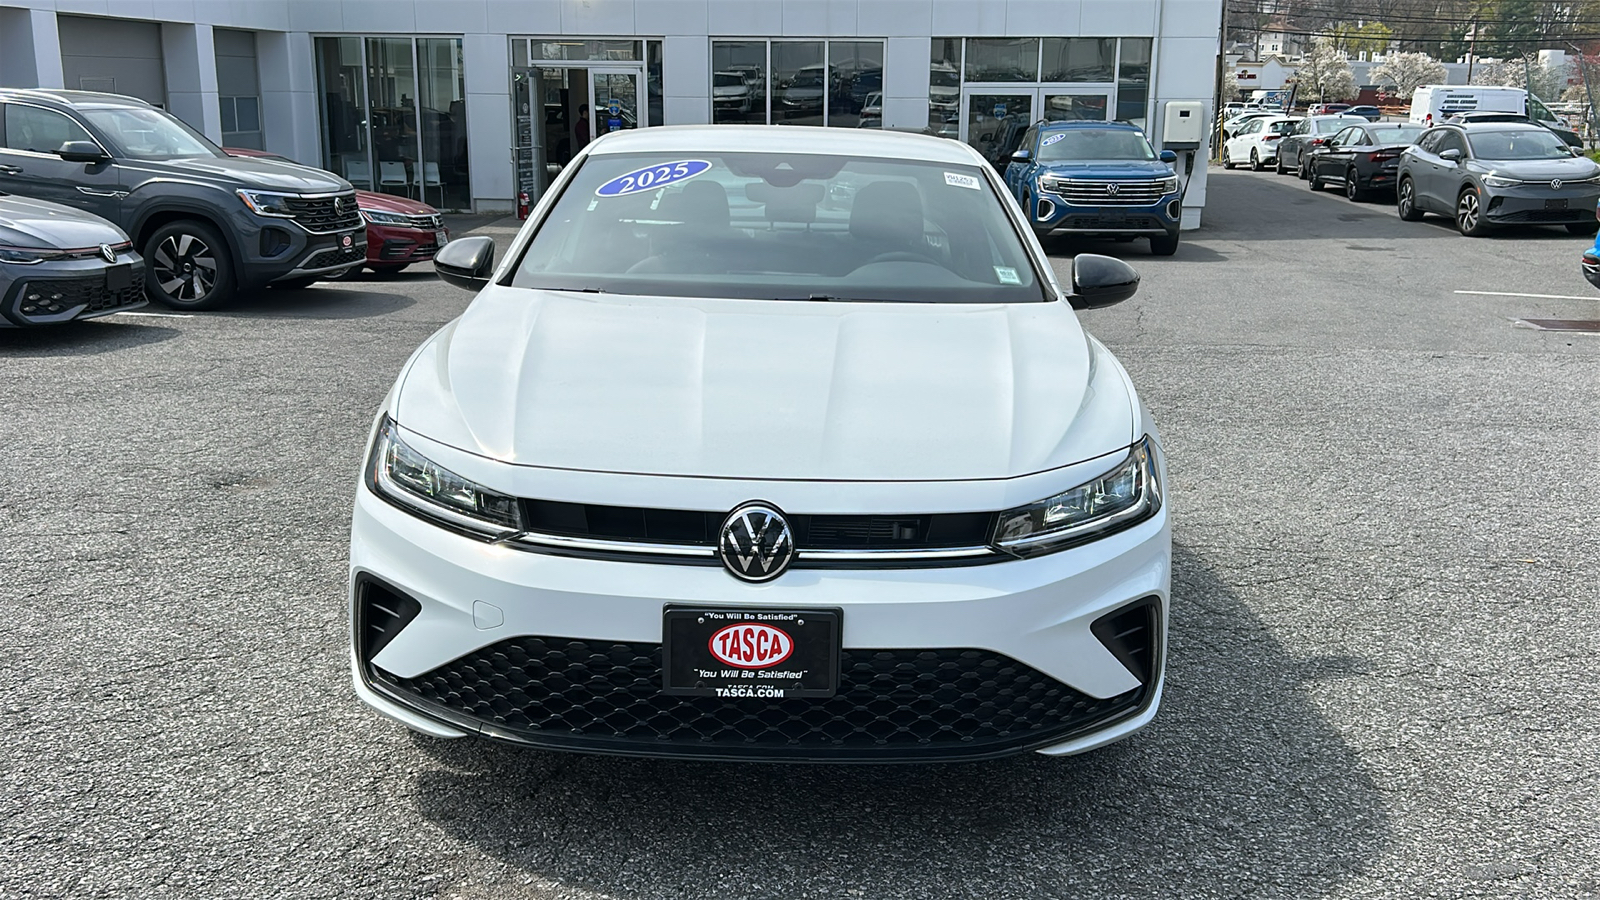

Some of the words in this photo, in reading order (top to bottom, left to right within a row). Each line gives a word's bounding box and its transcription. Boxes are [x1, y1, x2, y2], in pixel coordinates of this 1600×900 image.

[618, 161, 689, 194] 2025
[726, 612, 742, 620] Will
[718, 627, 783, 662] TASCA
[720, 669, 739, 678] Will
[741, 670, 755, 679] Be
[715, 688, 784, 698] TASCA.COM
